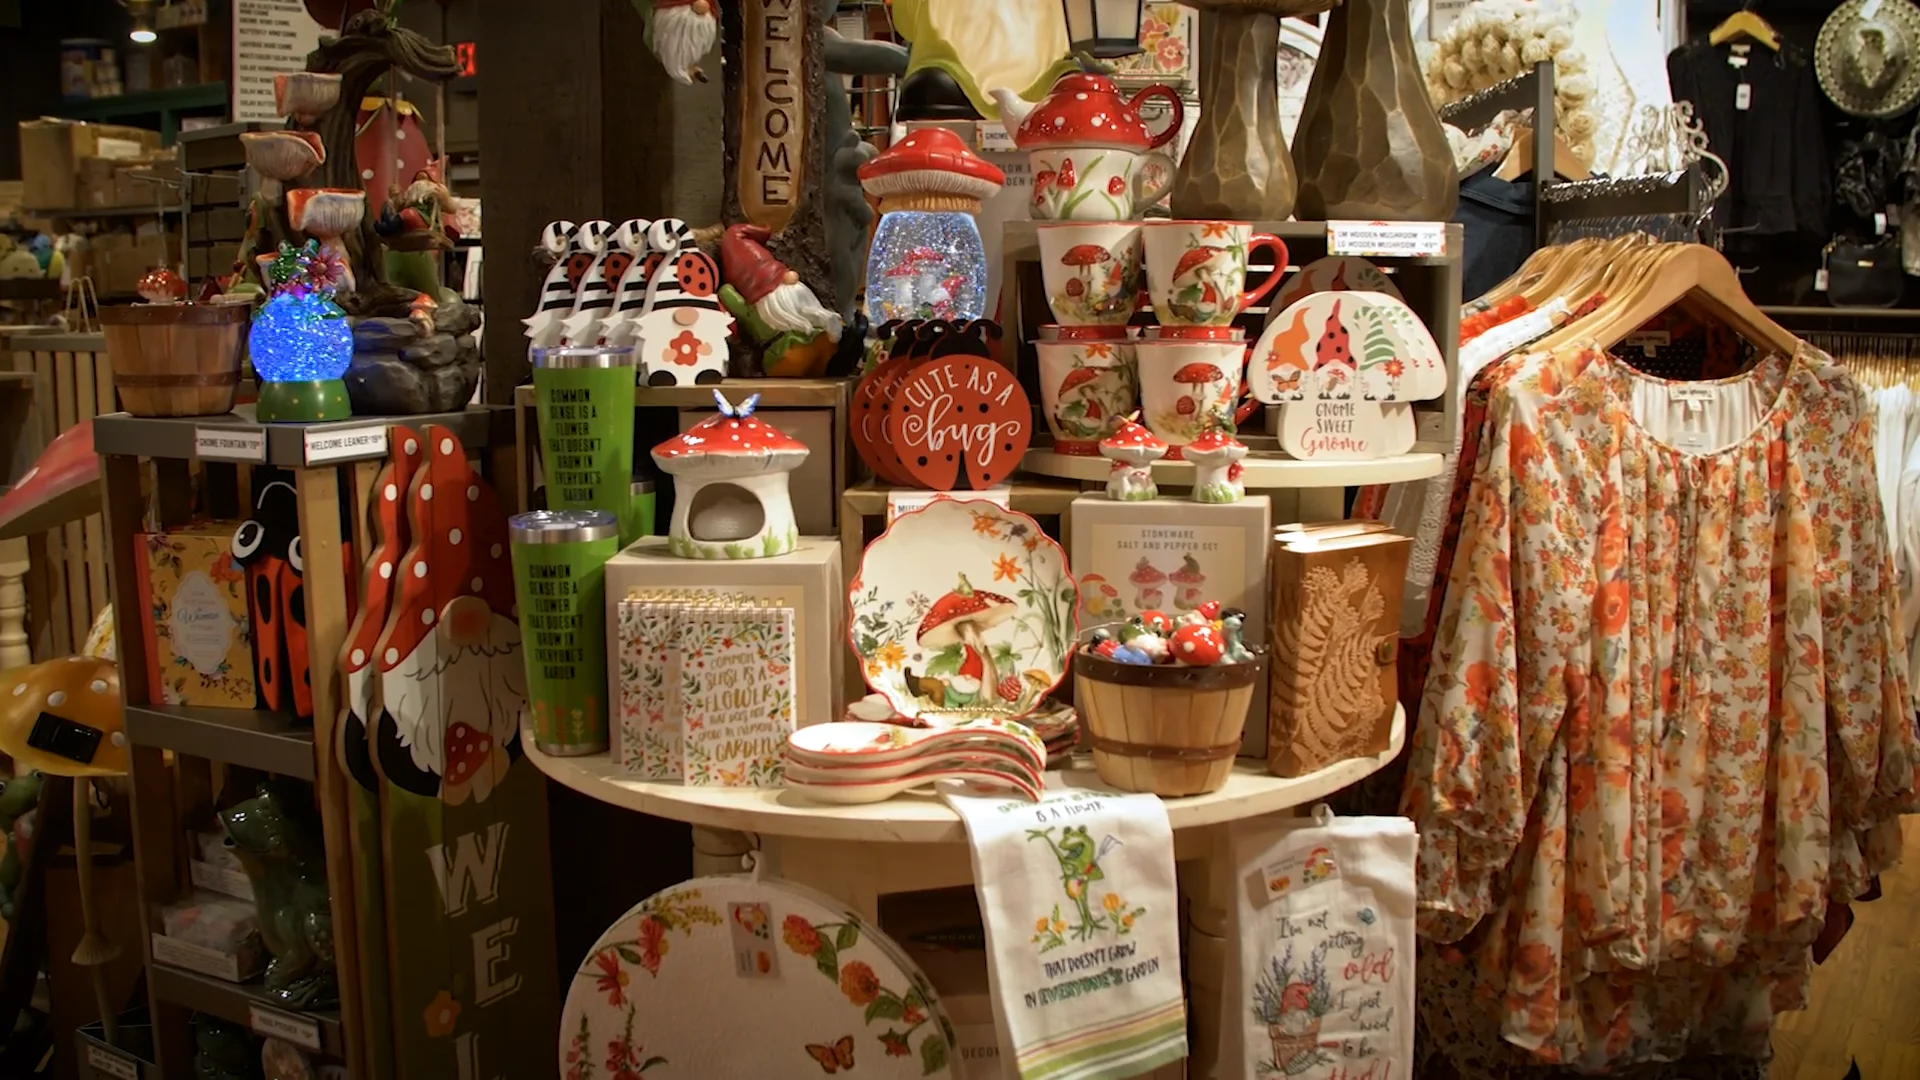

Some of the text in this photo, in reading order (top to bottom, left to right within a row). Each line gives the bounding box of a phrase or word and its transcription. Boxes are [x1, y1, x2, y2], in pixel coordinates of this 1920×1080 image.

[985, 132, 1008, 140] GNOME
[904, 364, 1014, 408] CUTE AS A
[550, 388, 590, 402] COMMON
[550, 404, 597, 420] SENSE IS A
[1316, 402, 1356, 417] GNOME
[556, 422, 590, 436] FLOWER
[902, 394, 1021, 467] bug
[1316, 418, 1355, 434] SWEET
[200, 438, 218, 448] GNOME
[220, 438, 247, 448] FOUNTAIN
[310, 437, 342, 451] WELCOME
[344, 435, 369, 447] LEANER
[548, 438, 566, 452] THAT
[557, 455, 594, 468] GROW IN
[562, 488, 594, 502] GARDEN
[1141, 529, 1195, 540] STONEWARE
[1117, 540, 1218, 551] SALT AND PEPPER SET
[529, 564, 571, 579] COMMON
[528, 580, 578, 596] SENSE IS A
[535, 598, 570, 612] FLOWER
[527, 614, 545, 629] THAT
[536, 632, 574, 646] GROW IN
[710, 652, 755, 670] COMMON
[544, 666, 576, 680] GARDEN
[704, 666, 767, 692] SENSE IS A
[704, 683, 772, 713] FLOWER
[716, 736, 774, 763] GARDEN
[1276, 910, 1329, 940] I'm not
[1316, 930, 1366, 961] getting
[1043, 958, 1066, 980] THAT
[1108, 941, 1137, 962] GROW
[1342, 947, 1395, 984] old
[1024, 991, 1037, 1009] IN
[1124, 956, 1160, 983] GARDEN
[1338, 989, 1382, 1022] I just
[1360, 1006, 1394, 1032] need
[1342, 1037, 1375, 1056] to be
